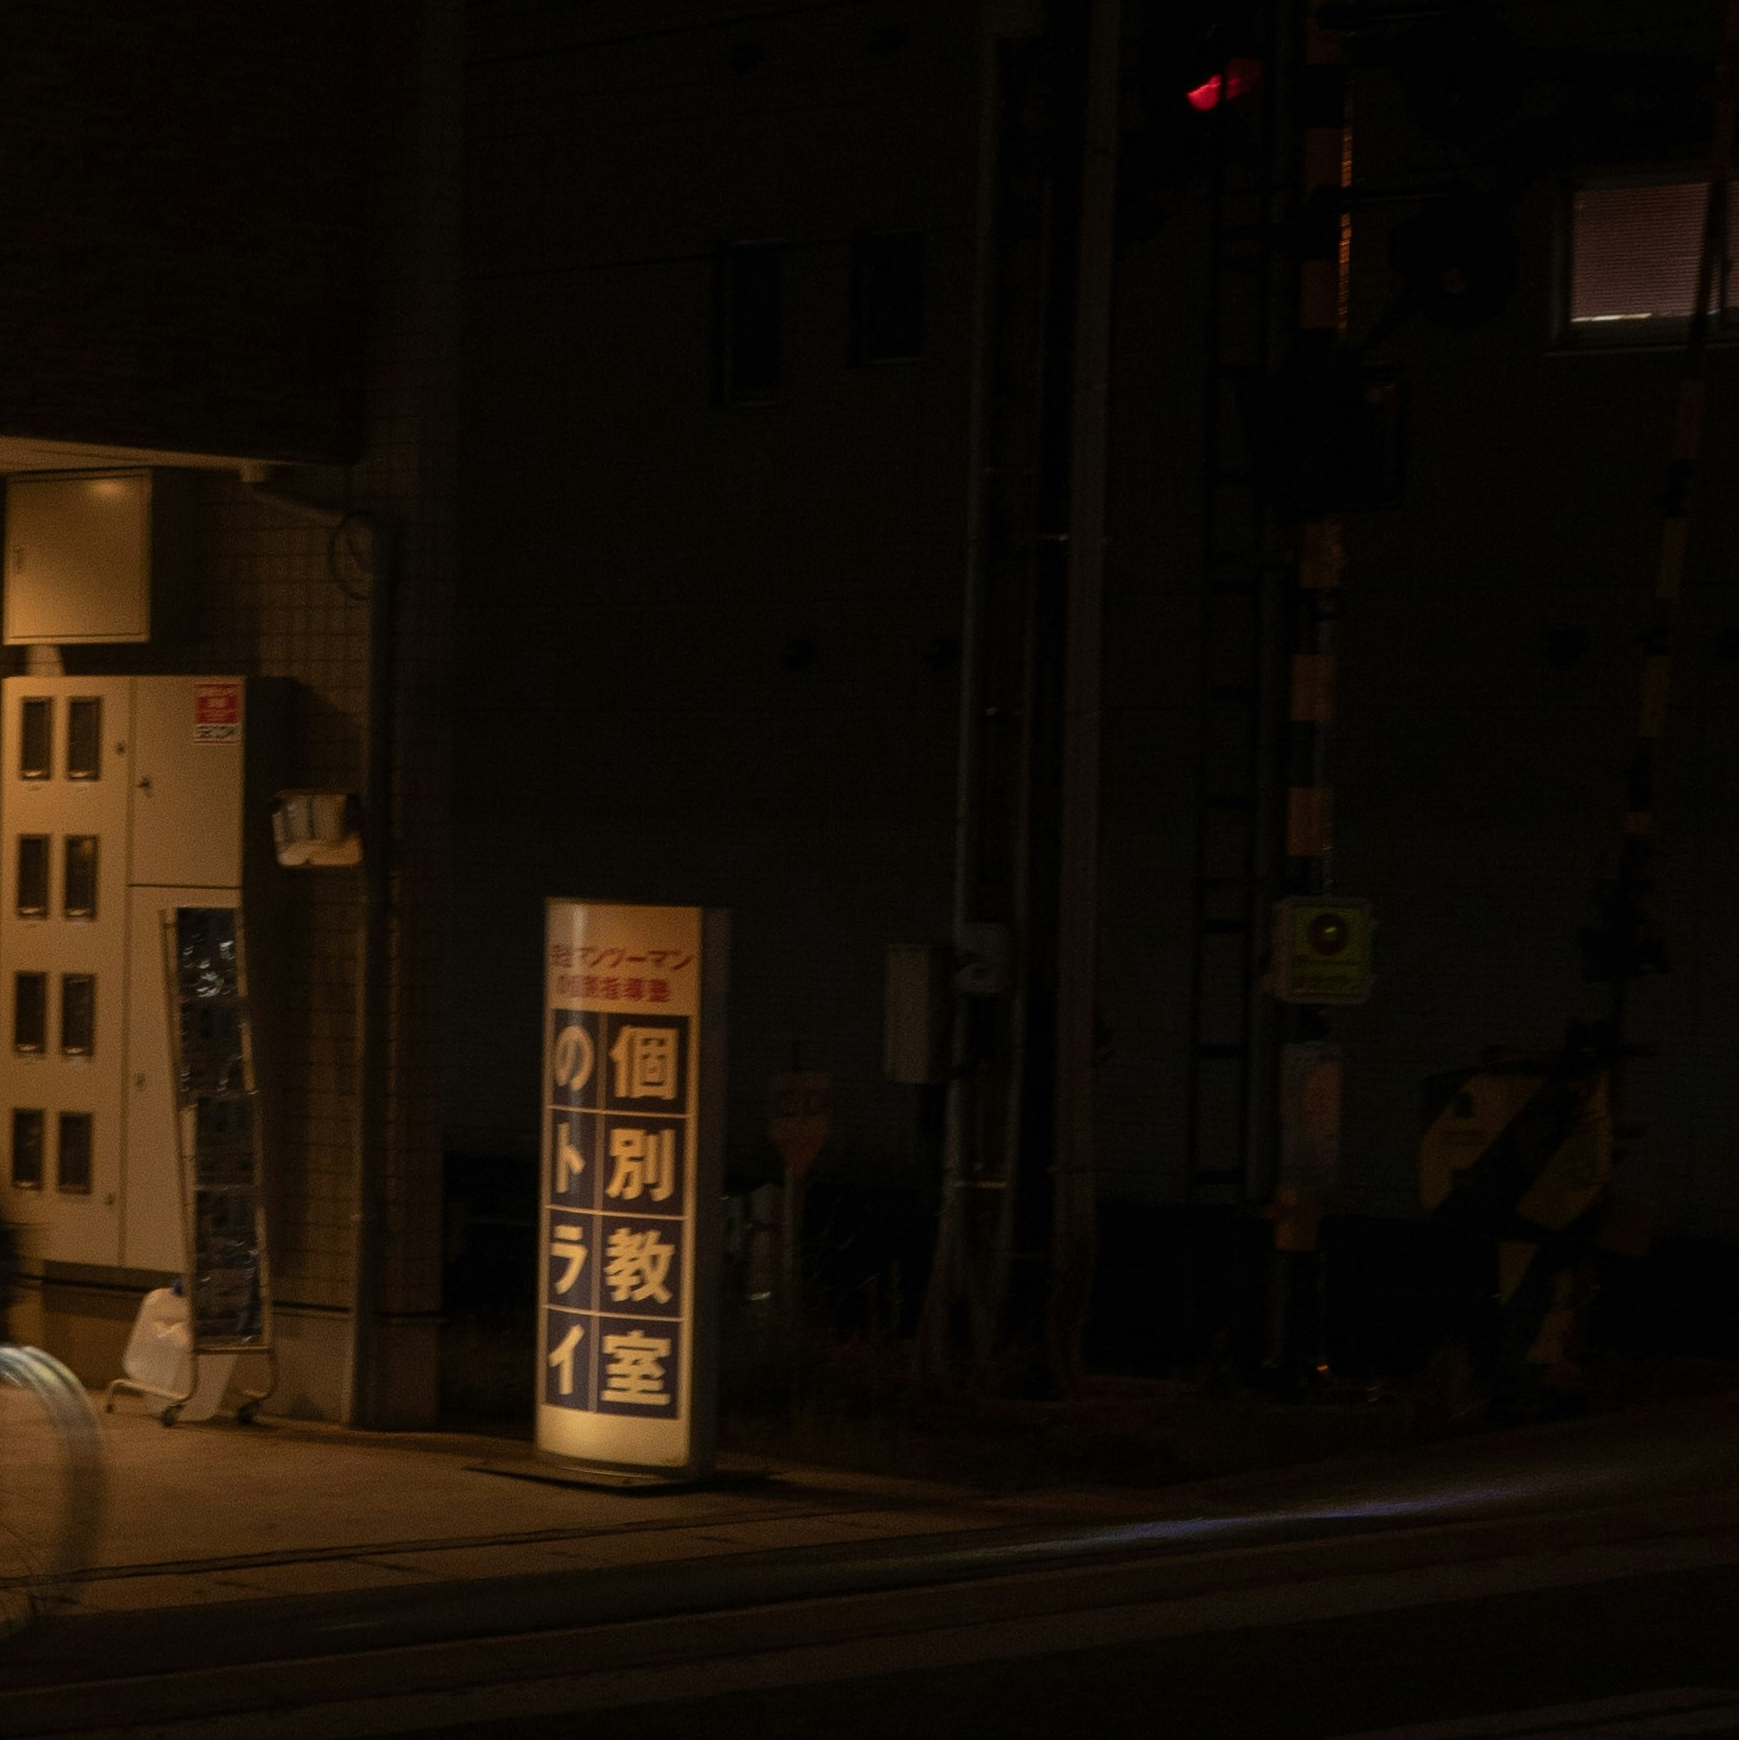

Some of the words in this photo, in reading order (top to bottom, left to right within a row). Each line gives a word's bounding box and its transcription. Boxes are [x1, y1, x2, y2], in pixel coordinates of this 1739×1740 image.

[547, 1024, 595, 1396] のトライ
[601, 1024, 680, 1406] 個別教室
